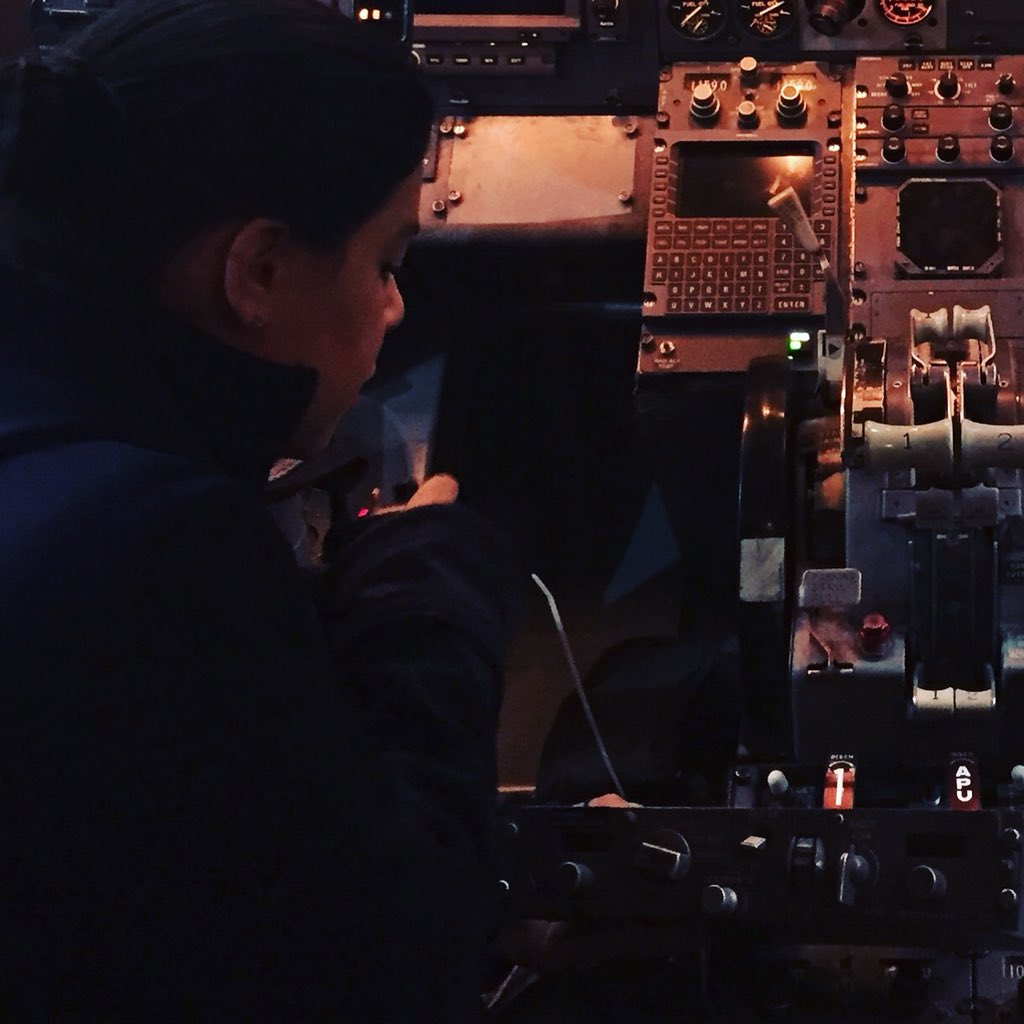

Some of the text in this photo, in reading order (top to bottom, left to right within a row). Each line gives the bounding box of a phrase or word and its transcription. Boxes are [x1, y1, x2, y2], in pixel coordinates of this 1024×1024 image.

[778, 300, 805, 308] ENTER
[904, 432, 912, 450] 1
[997, 432, 1012, 449] 2
[834, 768, 845, 806] 1
[955, 766, 973, 802] APU
